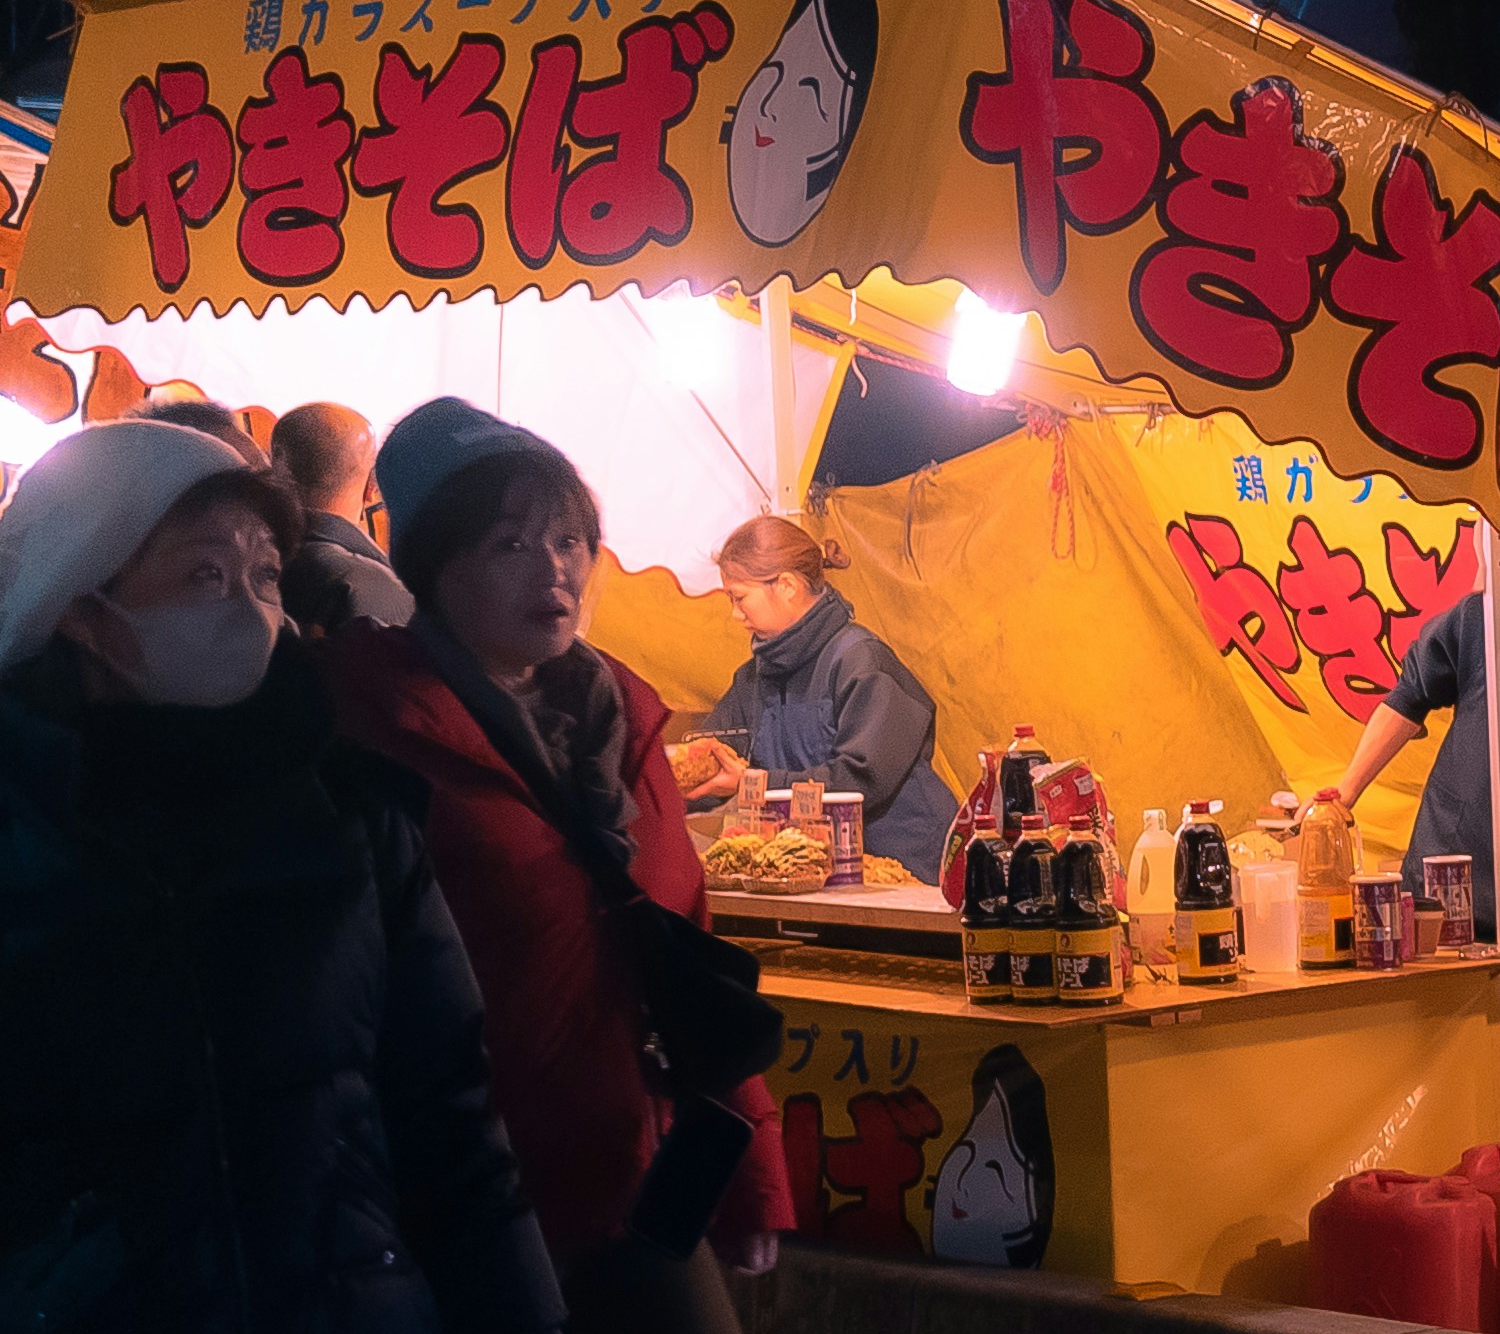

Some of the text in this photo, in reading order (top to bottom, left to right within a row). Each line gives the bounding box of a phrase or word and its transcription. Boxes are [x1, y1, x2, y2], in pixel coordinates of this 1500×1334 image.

[109, 0, 735, 293] やきそば
[786, 1022, 921, 1086] プ入り
